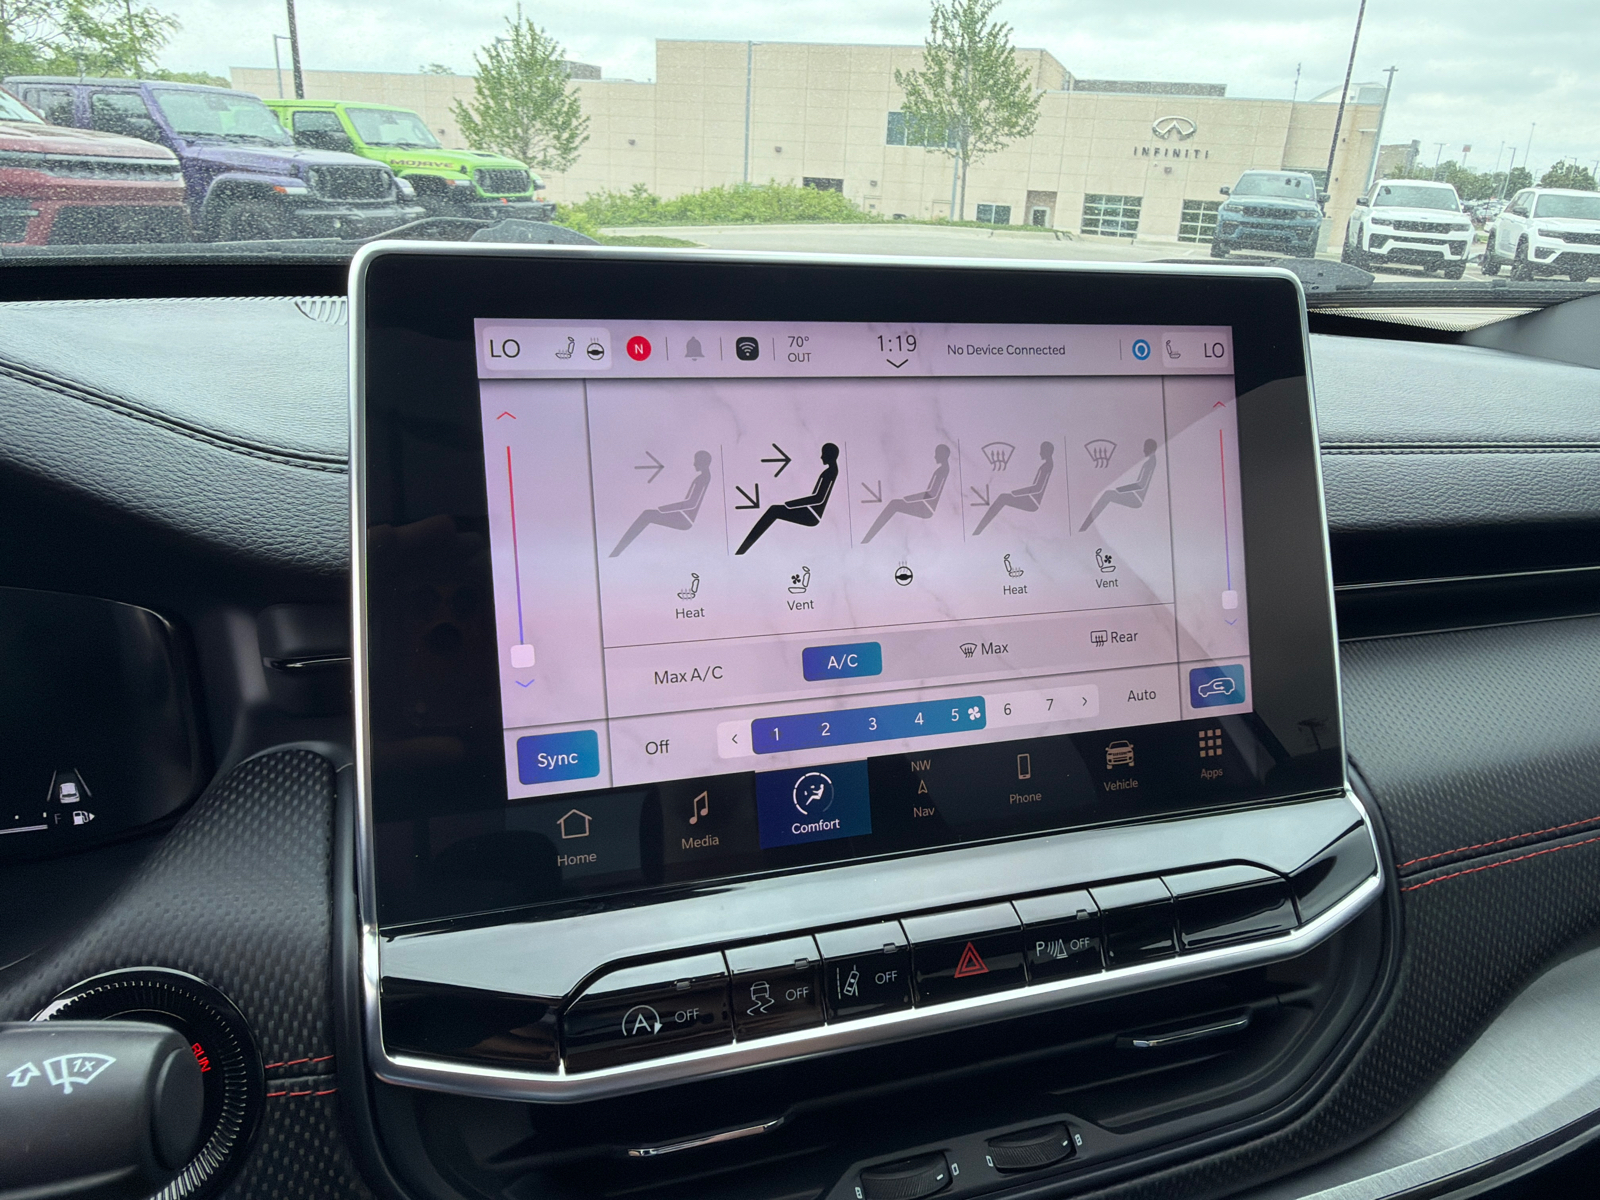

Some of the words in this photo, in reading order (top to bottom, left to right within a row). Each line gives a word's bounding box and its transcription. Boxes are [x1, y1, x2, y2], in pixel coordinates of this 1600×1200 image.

[1133, 146, 1209, 159] INFINITI
[390, 160, 453, 168] MOJAVE
[788, 336, 809, 347] 70°
[878, 335, 916, 351] 1:19
[490, 339, 520, 358] LO
[635, 344, 643, 354] N
[948, 345, 963, 355] No
[967, 344, 1003, 355] Device
[1006, 345, 1065, 355] Connected
[1204, 343, 1224, 358] LO
[788, 353, 811, 362] OUT
[1096, 579, 1118, 588] Vent
[1004, 585, 1027, 595] Heat
[787, 600, 814, 610] Vent
[676, 608, 704, 619] Heat
[1111, 632, 1138, 643] Rear
[982, 642, 1008, 655] Max
[828, 654, 857, 669] A/C
[655, 671, 687, 684] Max
[691, 666, 722, 682] A/C
[1128, 690, 1156, 702] Auto
[774, 728, 778, 740] 1
[822, 723, 830, 735] 2
[869, 718, 877, 730] 3
[915, 712, 923, 725] 4
[952, 709, 959, 721] 5
[1004, 703, 1011, 715] 6
[1046, 699, 1053, 710] 7
[646, 740, 669, 755] Off
[538, 753, 577, 769] Sync
[911, 760, 930, 771] NW
[1201, 769, 1223, 779] Apps
[1104, 779, 1138, 791] Vehicle
[1010, 793, 1041, 804] Phone
[914, 807, 934, 817] Nav
[792, 819, 839, 834] Comfort
[682, 835, 719, 849] Media
[558, 854, 596, 866] Home
[1070, 938, 1089, 950] OFF
[875, 971, 897, 984] OFF
[786, 987, 808, 1000] OFF
[675, 1008, 699, 1022] OFF
[191, 1043, 211, 1073] RUN
